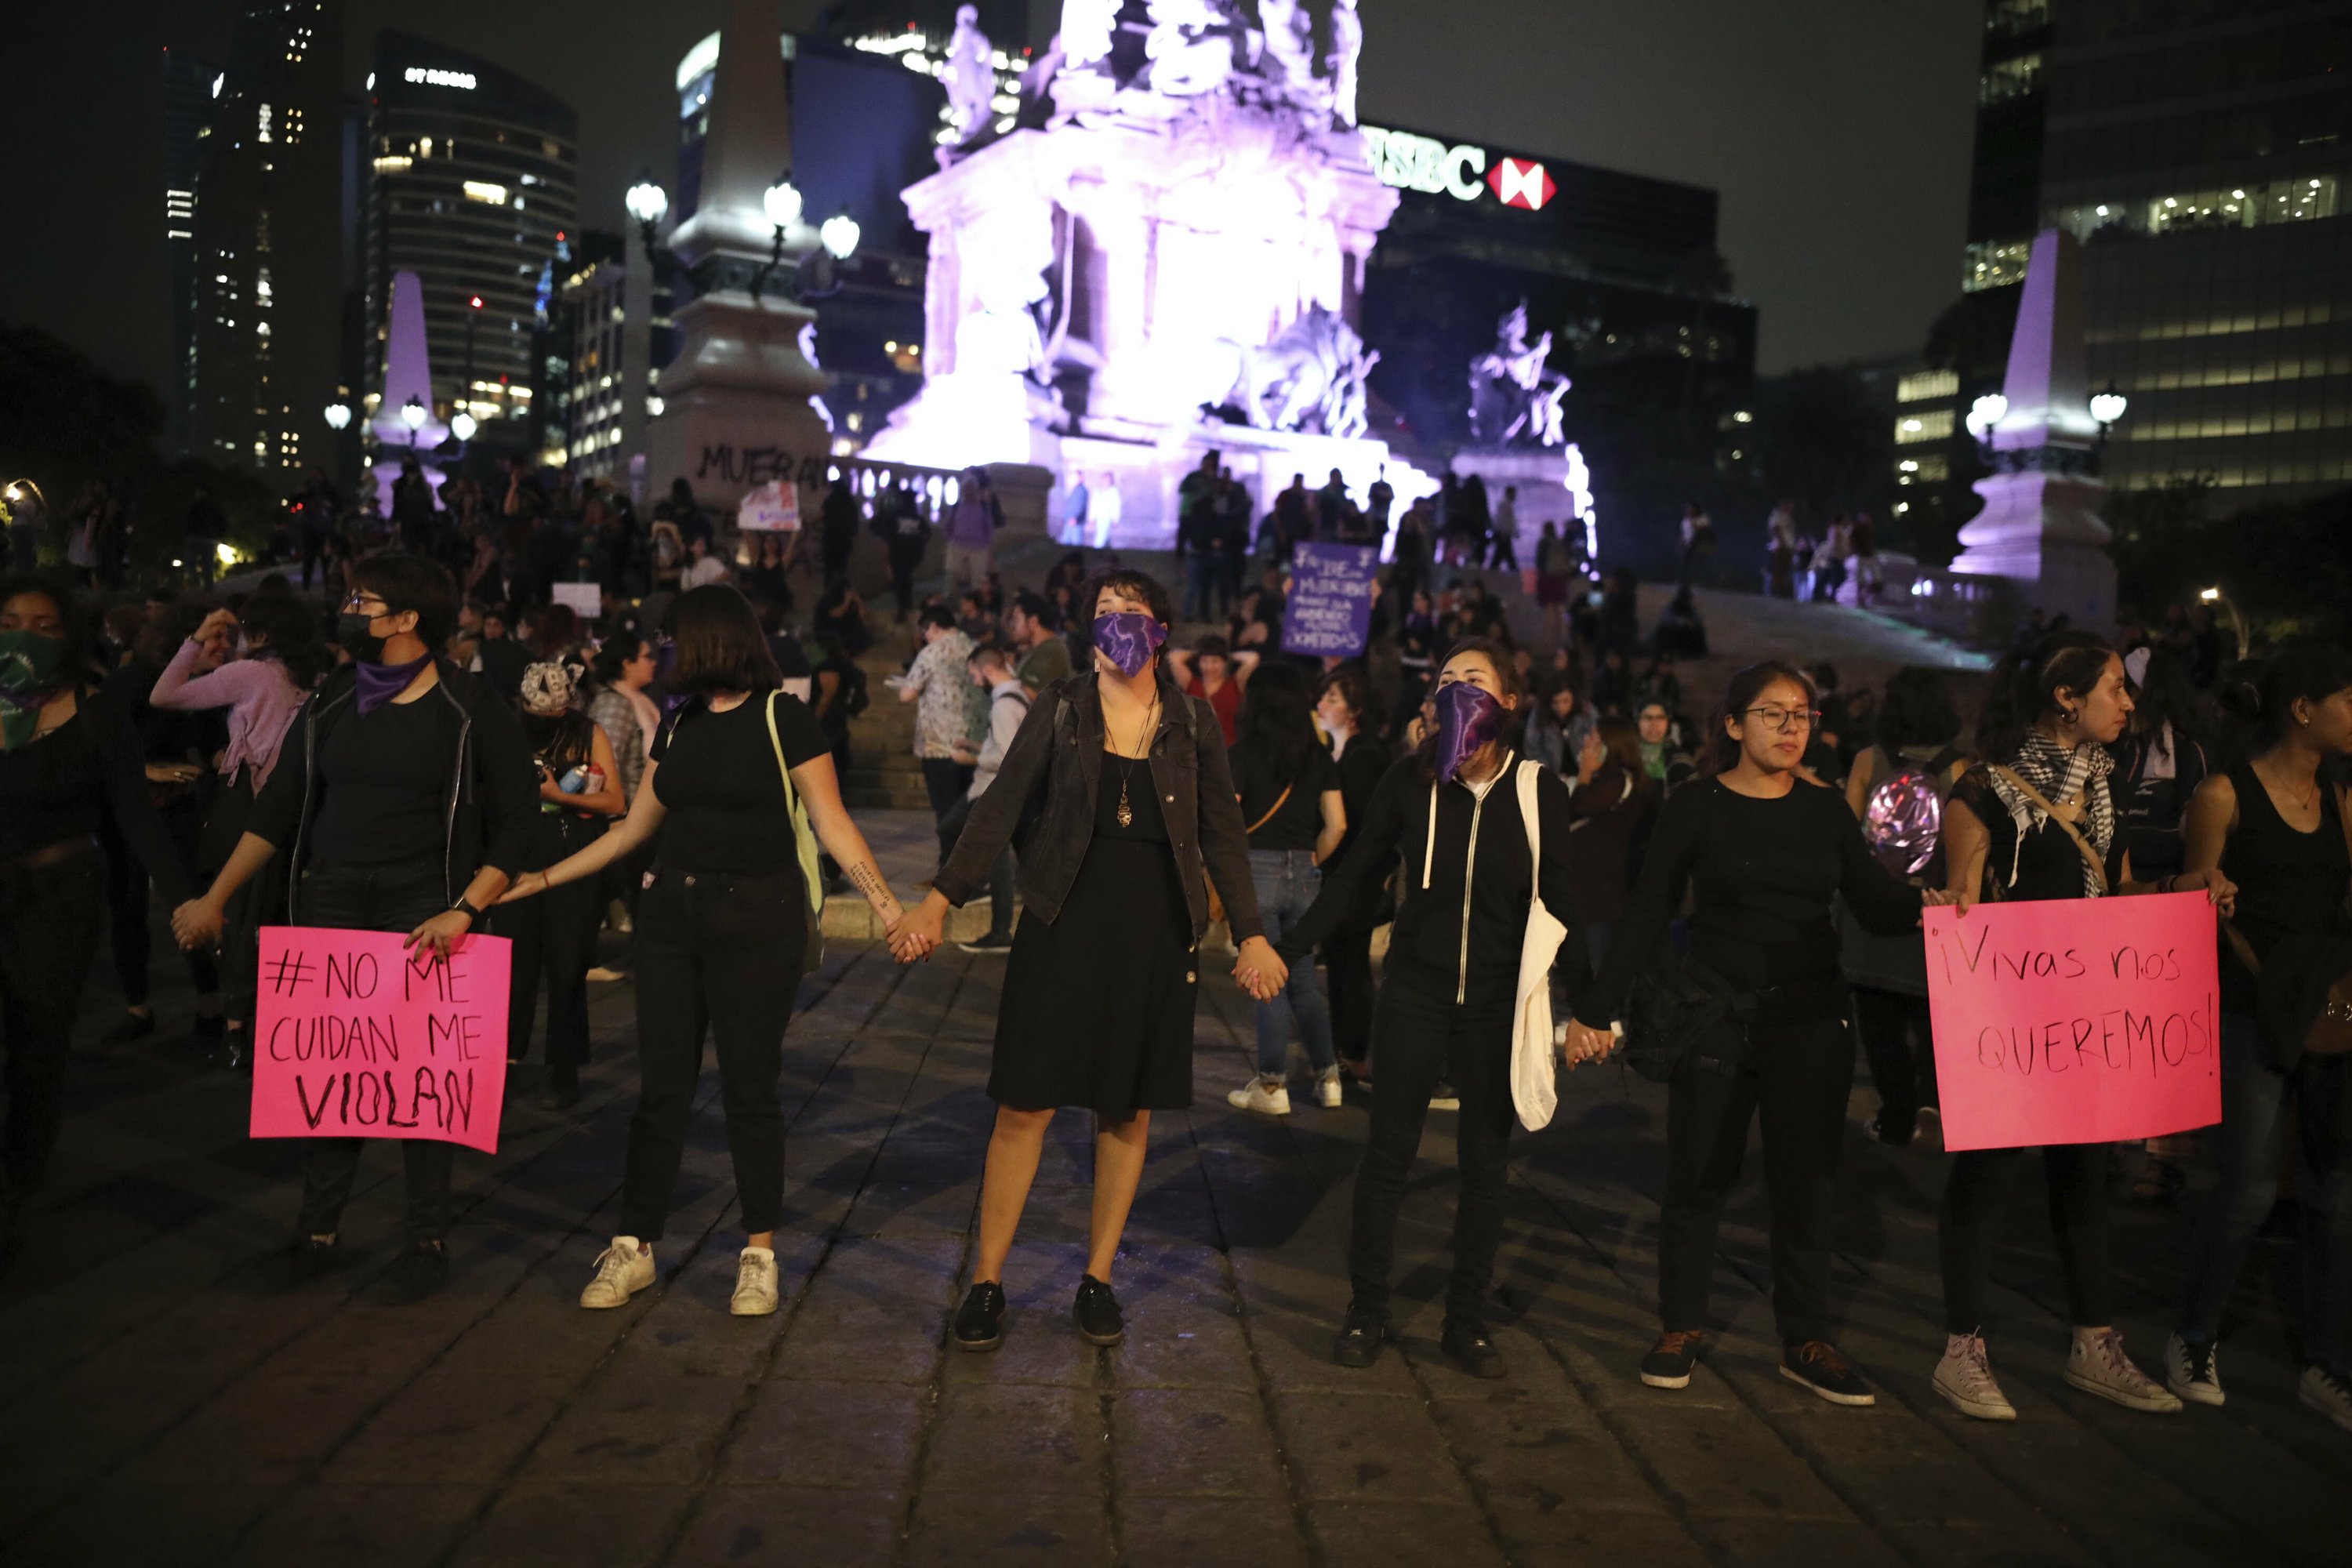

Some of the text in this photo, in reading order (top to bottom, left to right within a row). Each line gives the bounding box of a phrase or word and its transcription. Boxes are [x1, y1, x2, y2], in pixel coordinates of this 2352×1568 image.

[405, 951, 470, 1004] ME
[2111, 946, 2181, 981] nos
[270, 1013, 482, 1064] CUIDAN ME
[1978, 992, 2213, 1078] QUEREMOS!
[296, 1066, 474, 1134] VIOLAN
